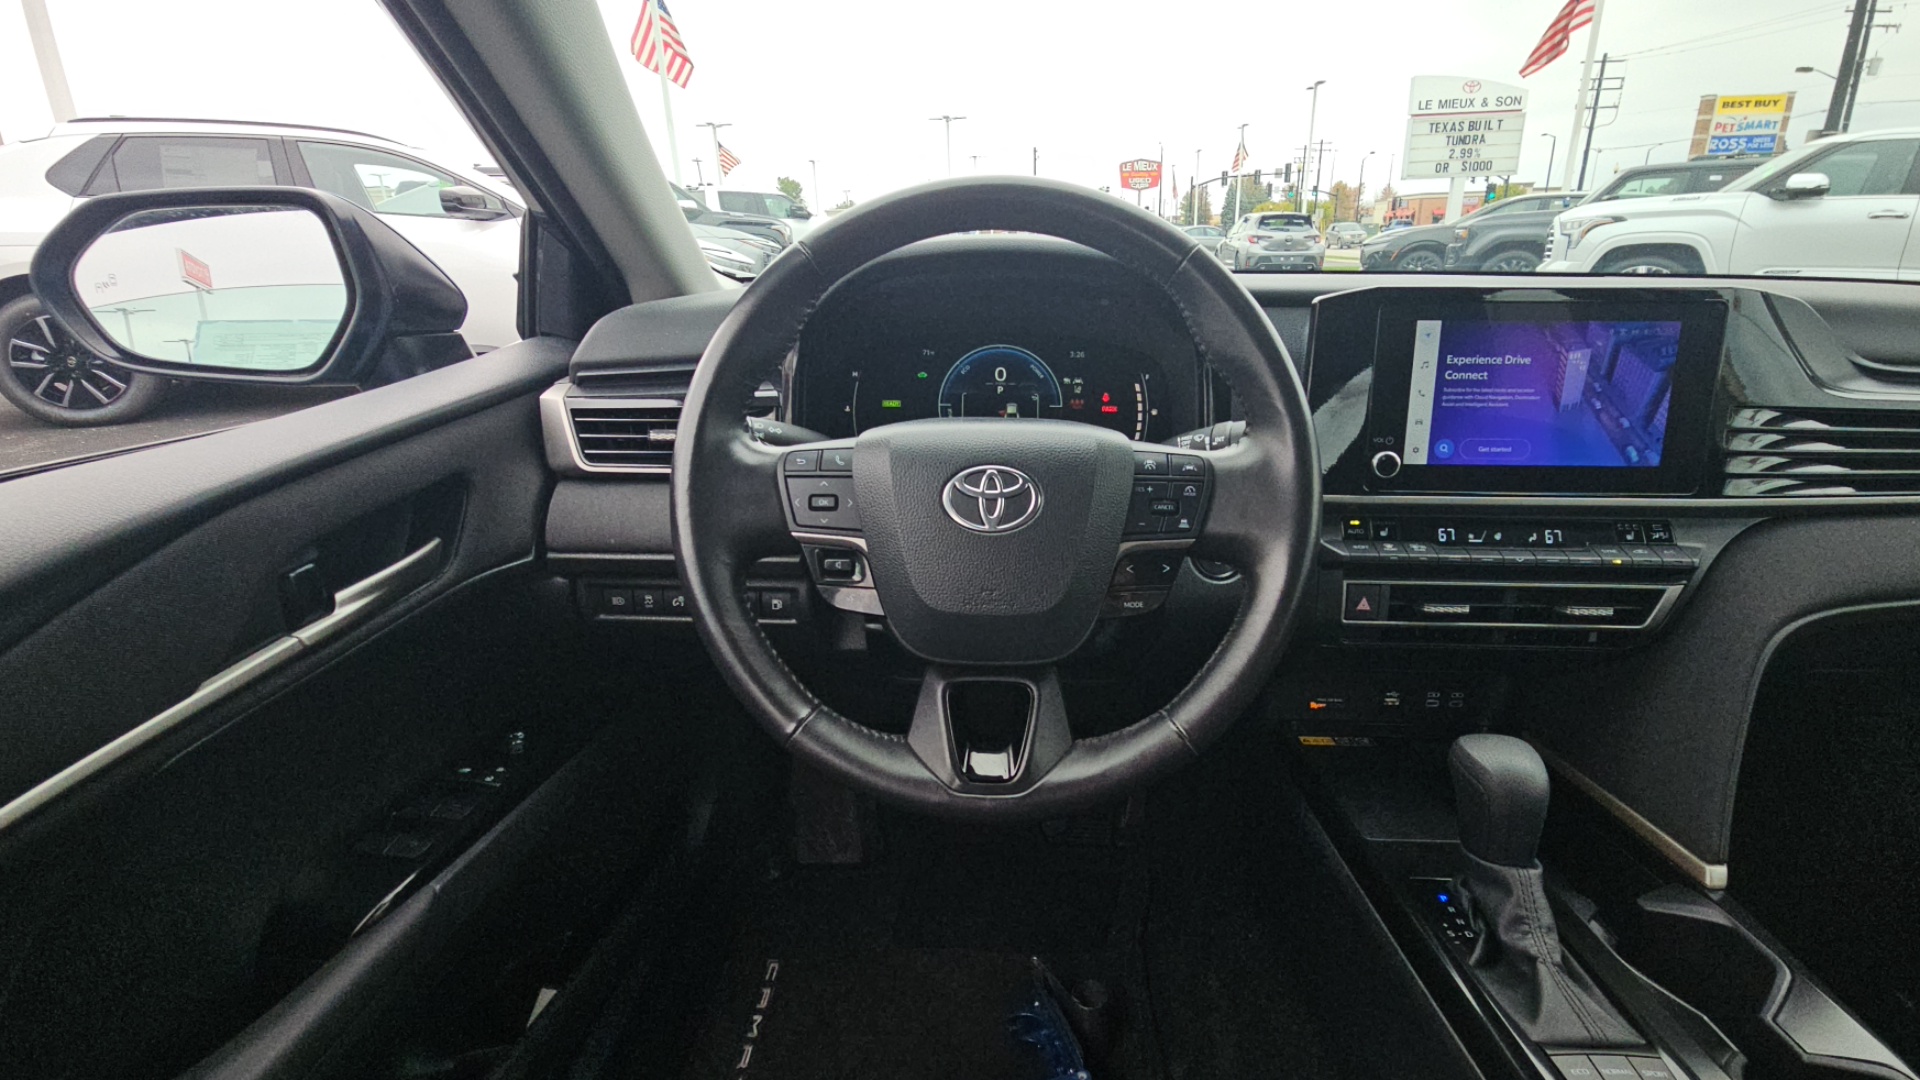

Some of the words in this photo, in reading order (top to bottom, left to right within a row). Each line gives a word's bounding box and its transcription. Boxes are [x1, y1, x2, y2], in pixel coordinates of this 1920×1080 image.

[1418, 100, 1432, 110] LE
[1438, 98, 1475, 110] MIEUX
[1481, 97, 1488, 107] &
[1496, 96, 1522, 107] SON
[1722, 100, 1752, 108] BEST
[1754, 99, 1780, 108] BUY
[1429, 122, 1464, 133] TEXAS
[1468, 119, 1503, 131] BUILT
[1446, 134, 1486, 146] TUNDRA
[1709, 137, 1748, 150] ROSS
[1449, 148, 1481, 159] 2.99%
[1122, 163, 1132, 171] LE
[1435, 162, 1449, 173] OR
[1446, 354, 1502, 365] Experience
[1504, 354, 1531, 365] Drive
[1445, 370, 1488, 380] Connect
[997, 386, 1004, 394] P
[1438, 528, 1455, 542] 67
[1544, 530, 1562, 544] 67
